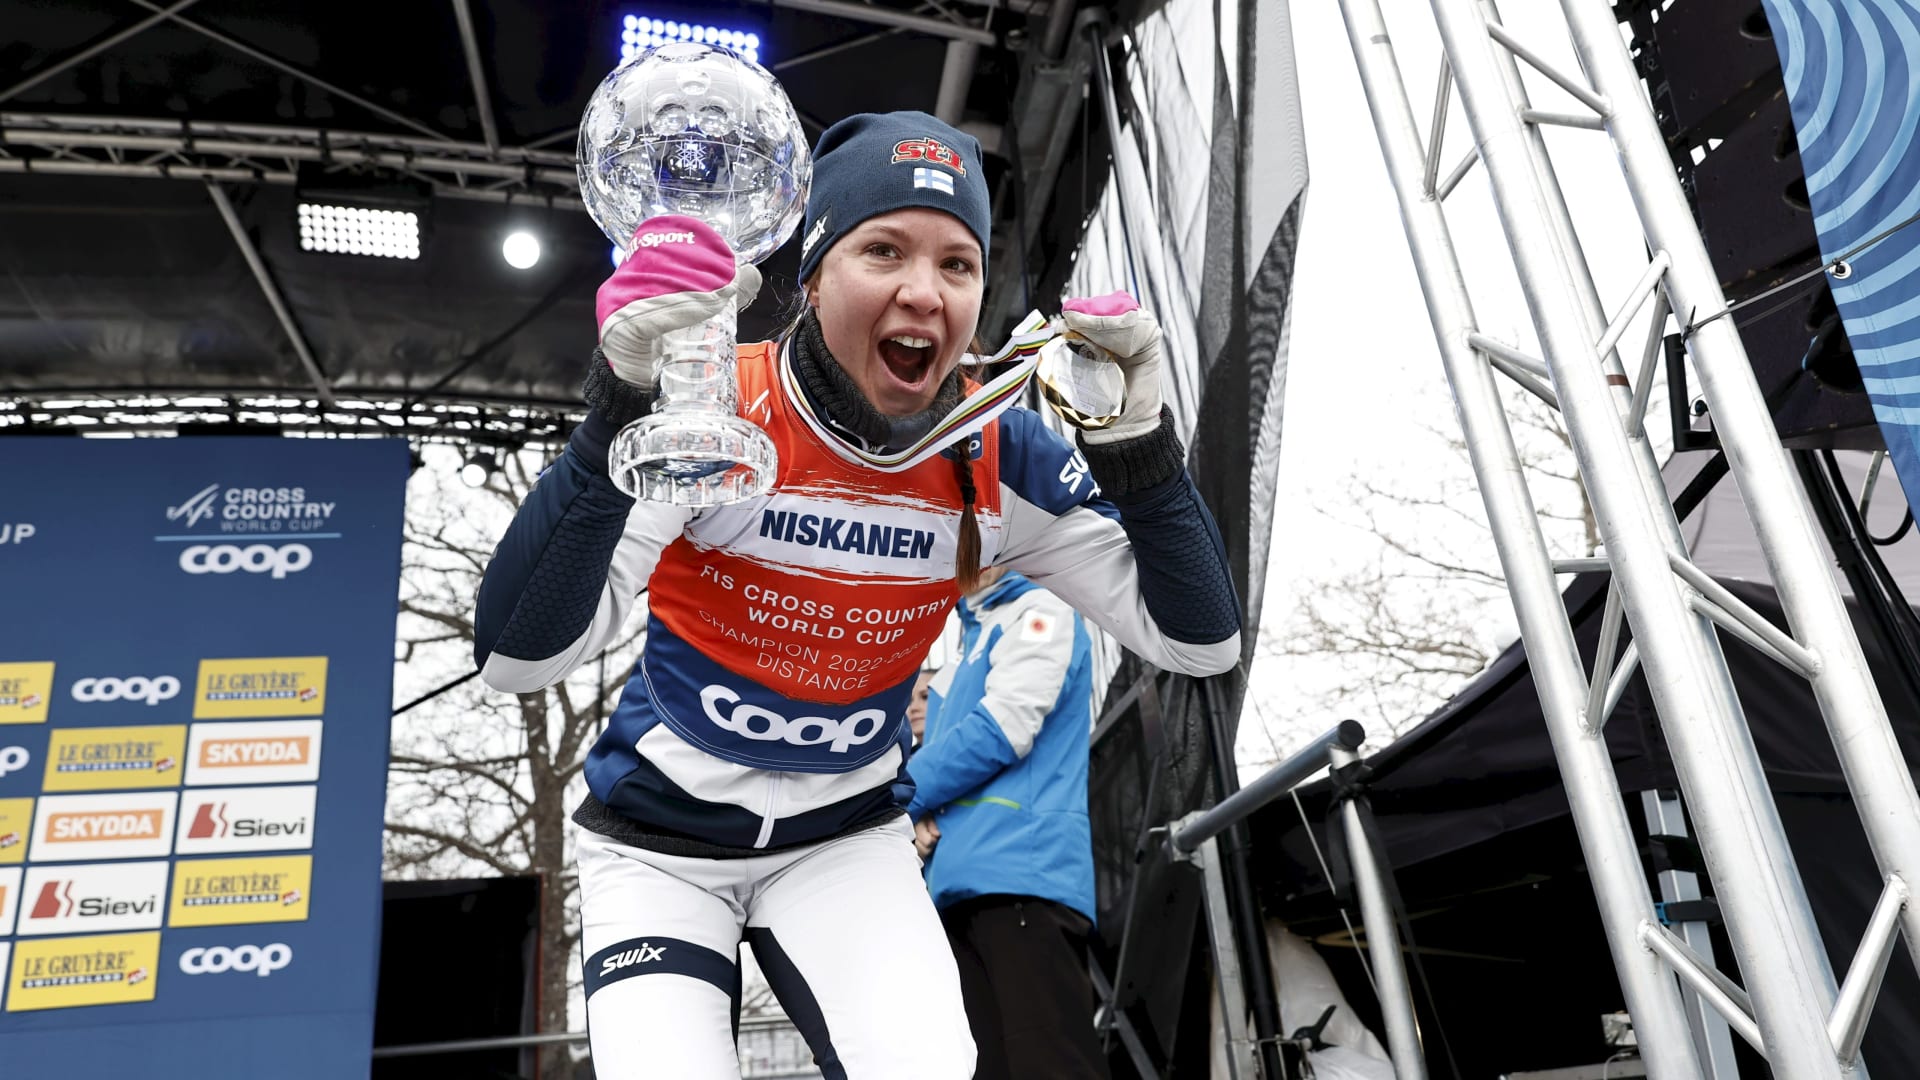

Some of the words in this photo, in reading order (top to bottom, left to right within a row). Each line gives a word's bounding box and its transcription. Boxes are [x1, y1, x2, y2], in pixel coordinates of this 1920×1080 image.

[224, 487, 306, 504] CROSS
[222, 502, 336, 520] COUNTRY
[220, 520, 282, 532] WORLD
[288, 519, 324, 531] CUP
[759, 509, 935, 559] NISKANEN
[179, 543, 313, 579] coop
[700, 565, 735, 590] FIS
[743, 584, 835, 620] CROSS
[845, 596, 950, 626] COUNTRY
[698, 609, 820, 665] CHAMPION
[748, 606, 845, 640] WORLD
[856, 628, 905, 645] CUP
[207, 674, 226, 690] LE
[228, 671, 299, 690] GRUYÈRE
[756, 652, 871, 692] DISTANCE
[71, 676, 181, 705] coop
[59, 744, 79, 761] LE
[81, 741, 155, 760] GRUYÈRE
[206, 742, 301, 763] SKYDDA
[54, 815, 154, 837] SKYDDA
[233, 817, 306, 838] Sievi
[184, 877, 205, 895] LE
[206, 872, 282, 894] GRUYÈRE
[79, 895, 155, 917] Sievi
[23, 957, 45, 977] LE
[47, 951, 127, 976] GRUYÈRE
[179, 942, 293, 976] coop
[599, 942, 667, 977] swix
